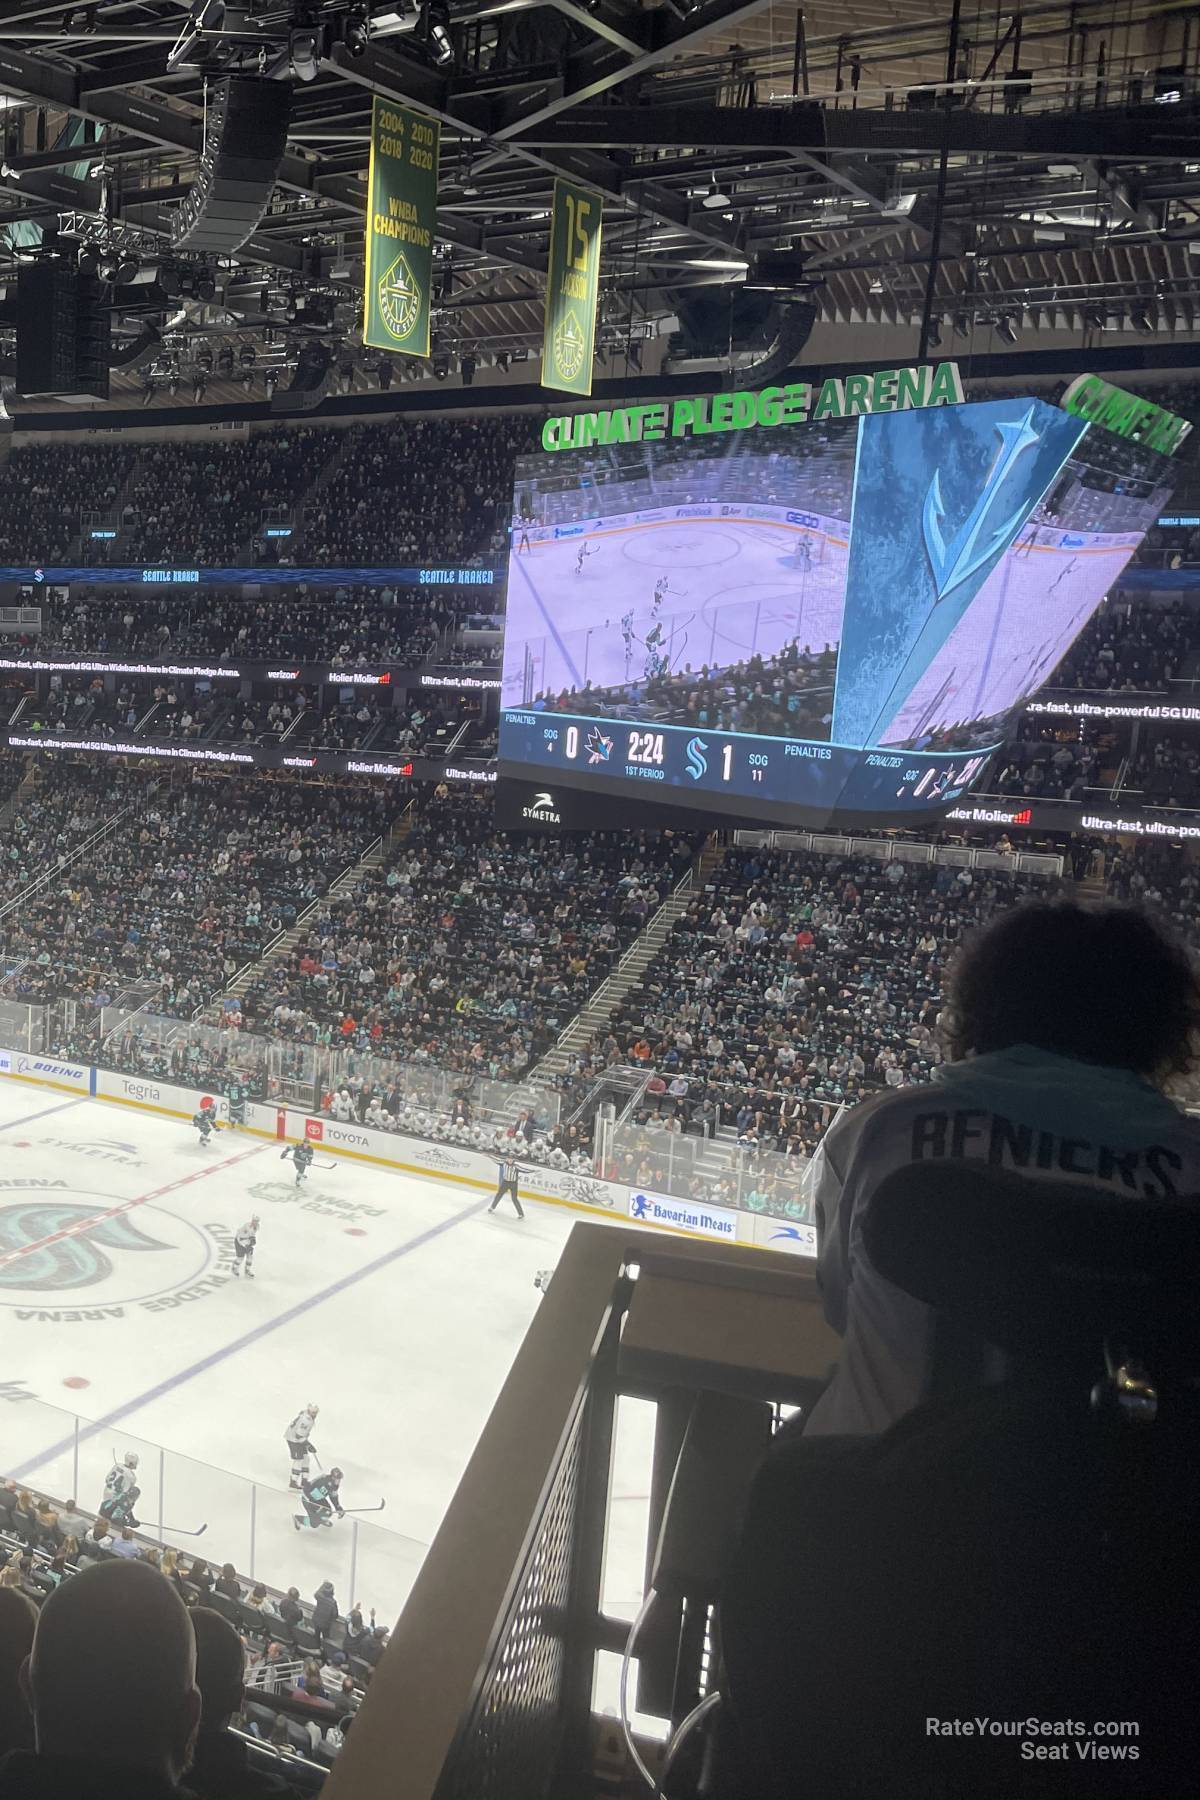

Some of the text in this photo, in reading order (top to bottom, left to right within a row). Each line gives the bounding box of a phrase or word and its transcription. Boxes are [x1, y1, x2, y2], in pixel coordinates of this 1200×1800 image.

[379, 108, 434, 147] 2004 2010
[409, 146, 433, 170] 2020
[389, 197, 417, 222] WNBA
[374, 213, 430, 248] CHAMPIONS
[566, 194, 591, 272] 15
[542, 361, 965, 452] CLIMATE PLEDGE ARENA
[786, 511, 819, 529] GEICO
[142, 569, 199, 583] SEATTLE KRAKEN
[420, 569, 493, 584] SEATTLE KRAKEN
[0, 660, 31, 669] Ultra-fast,
[33, 660, 80, 670] ultra-powerful
[81, 662, 91, 670] 5G
[92, 662, 108, 671] Ultra
[109, 663, 140, 672] Wideband
[169, 665, 193, 675] Climate
[194, 667, 216, 677] Pledge
[268, 671, 297, 680] verizon
[329, 673, 379, 684] Holier Molier
[422, 676, 460, 687] Ultra-fast,
[1073, 703, 1181, 718] ultra-powerful 5G
[505, 713, 536, 726] PENALTIES
[544, 728, 558, 740] SOG
[9, 737, 43, 748] Ultra-fast,
[44, 738, 90, 750] ultra-powerful
[91, 741, 100, 750] 5G
[101, 741, 116, 751] Ultra
[117, 743, 149, 753] Wideband
[179, 748, 204, 759] Climate
[205, 750, 229, 761] Pledge
[230, 752, 254, 762] Arena.
[547, 742, 553, 753] 4
[566, 726, 578, 759] 0
[628, 730, 663, 765] 2:24
[749, 753, 768, 766] SOG
[784, 744, 832, 760] PENALTIES
[284, 757, 316, 767] verizon
[348, 762, 401, 774] Holier Molier
[722, 744, 733, 780] 1
[865, 753, 904, 769] PENALTIES
[446, 768, 486, 782] Ultra-fast,
[625, 765, 665, 780] 1ST PERIOD
[752, 769, 763, 782] 11
[522, 808, 561, 824] SYMETRA
[973, 808, 1015, 822] Molier
[1082, 816, 1144, 834] Ultra-fast,
[33, 1062, 84, 1079] BOEING
[122, 1078, 160, 1101] Tegria
[327, 1128, 370, 1147] TOYOTA
[300, 1201, 362, 1223] Bank
[314, 1194, 389, 1217] WaFd
[653, 1203, 698, 1226] Bavarian
[700, 1212, 735, 1232] Meats
[139, 1274, 230, 1313] PLEDGE
[15, 1307, 126, 1323] ARENA
